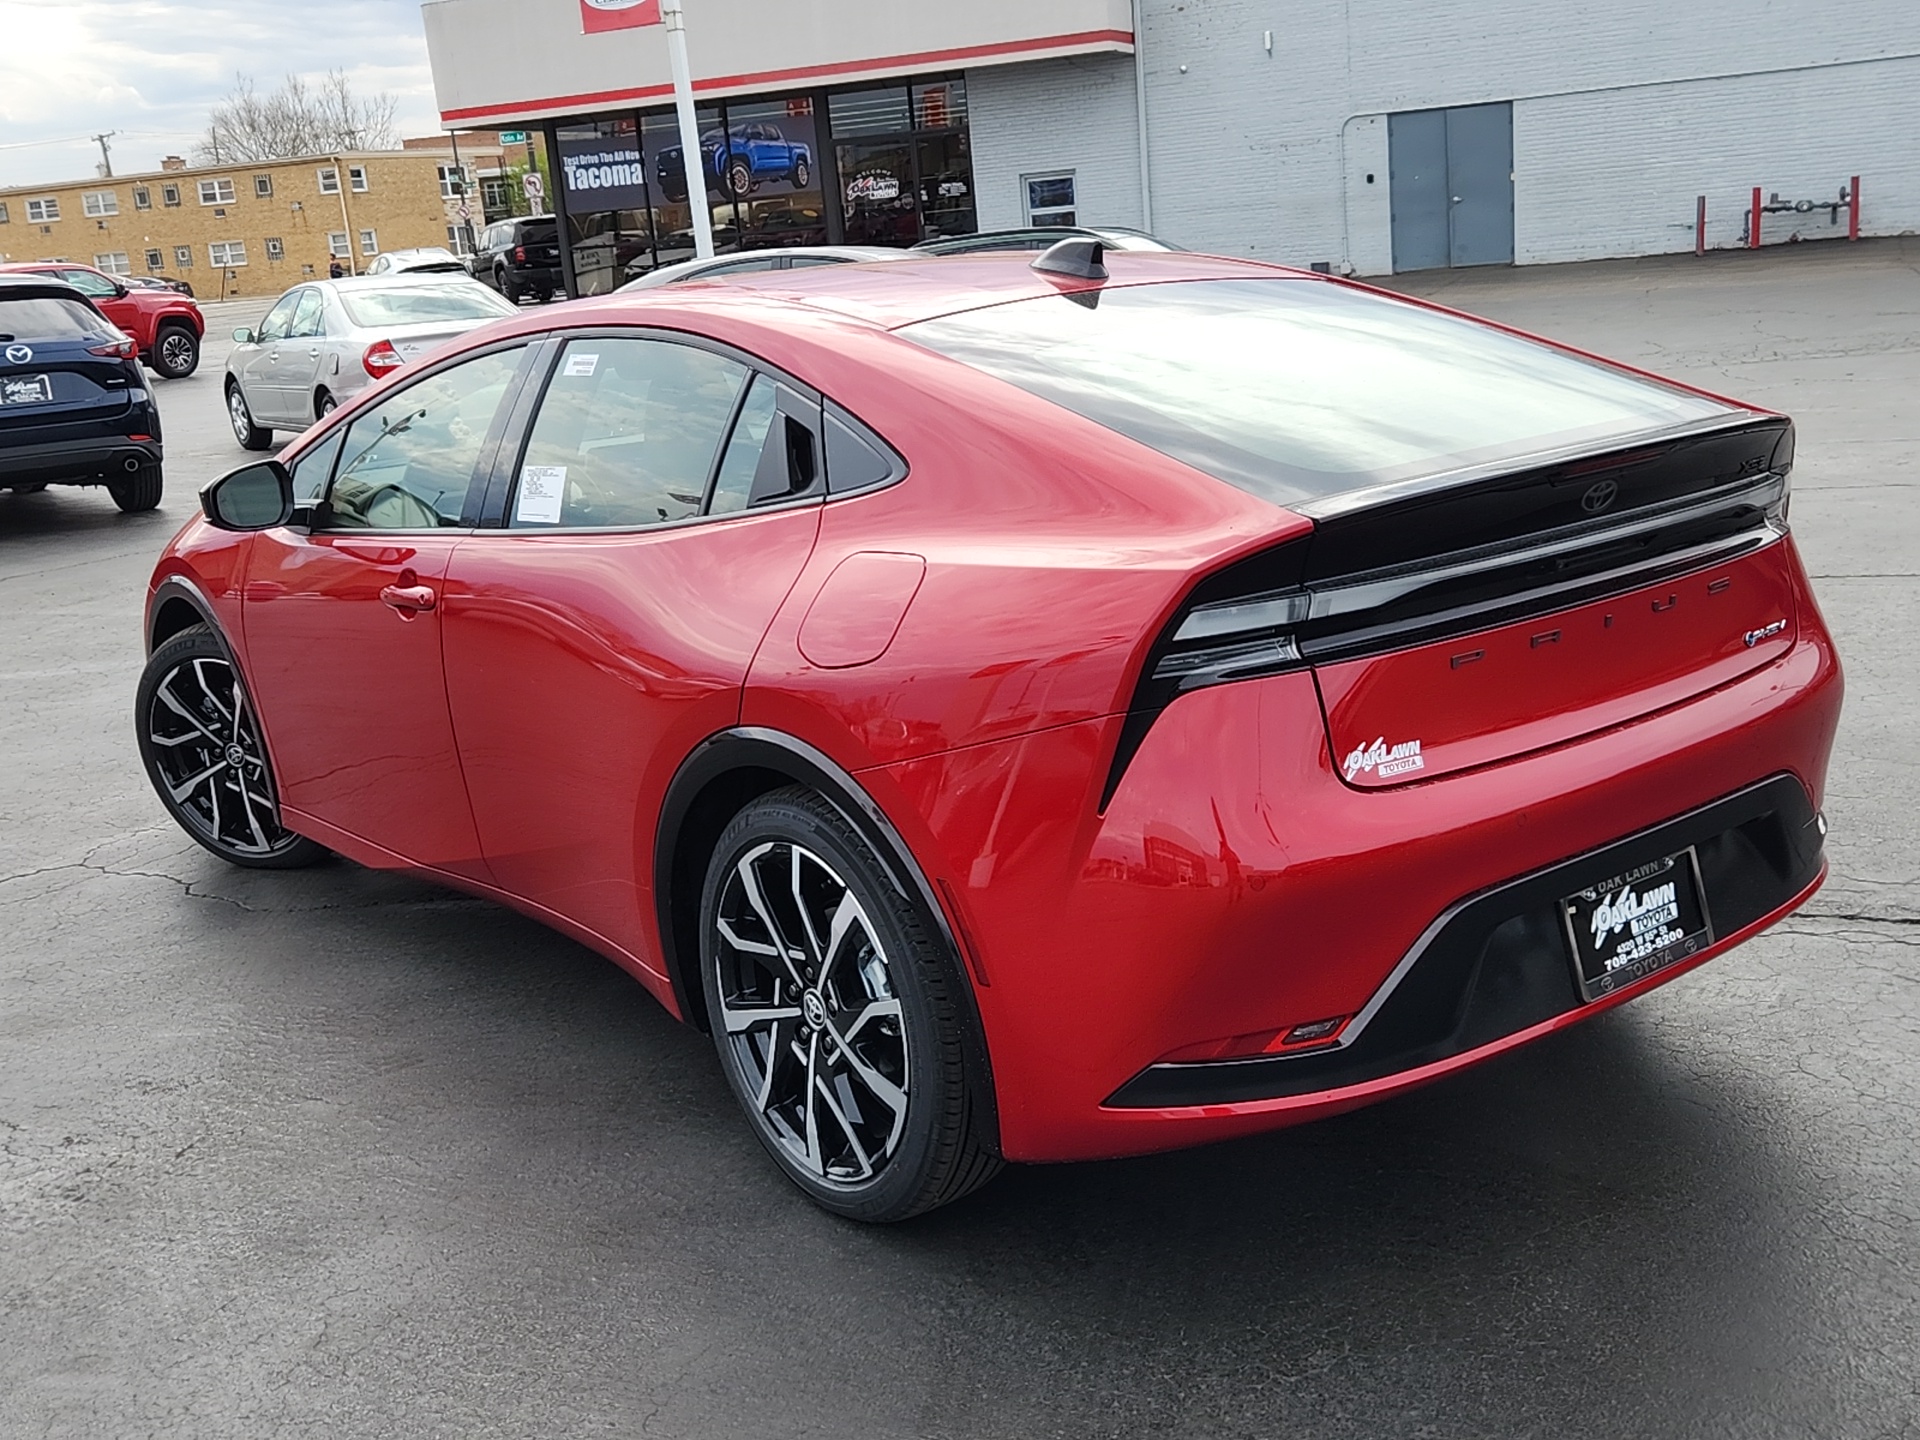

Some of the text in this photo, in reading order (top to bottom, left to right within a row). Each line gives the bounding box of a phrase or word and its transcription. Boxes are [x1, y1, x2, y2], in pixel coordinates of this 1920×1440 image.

[563, 156, 579, 166] Test
[579, 153, 599, 165] Drive
[599, 152, 613, 163] The
[614, 150, 625, 161] All
[564, 163, 643, 190] Tacoma
[1451, 577, 1730, 669] PRIUS
[1384, 759, 1418, 773] TOYOTA
[1598, 860, 1659, 893] OAK LAWN
[1636, 906, 1674, 930] TOYOTA
[1604, 928, 1684, 971] 708-423-5200
[1625, 949, 1674, 979] TOYOTA
